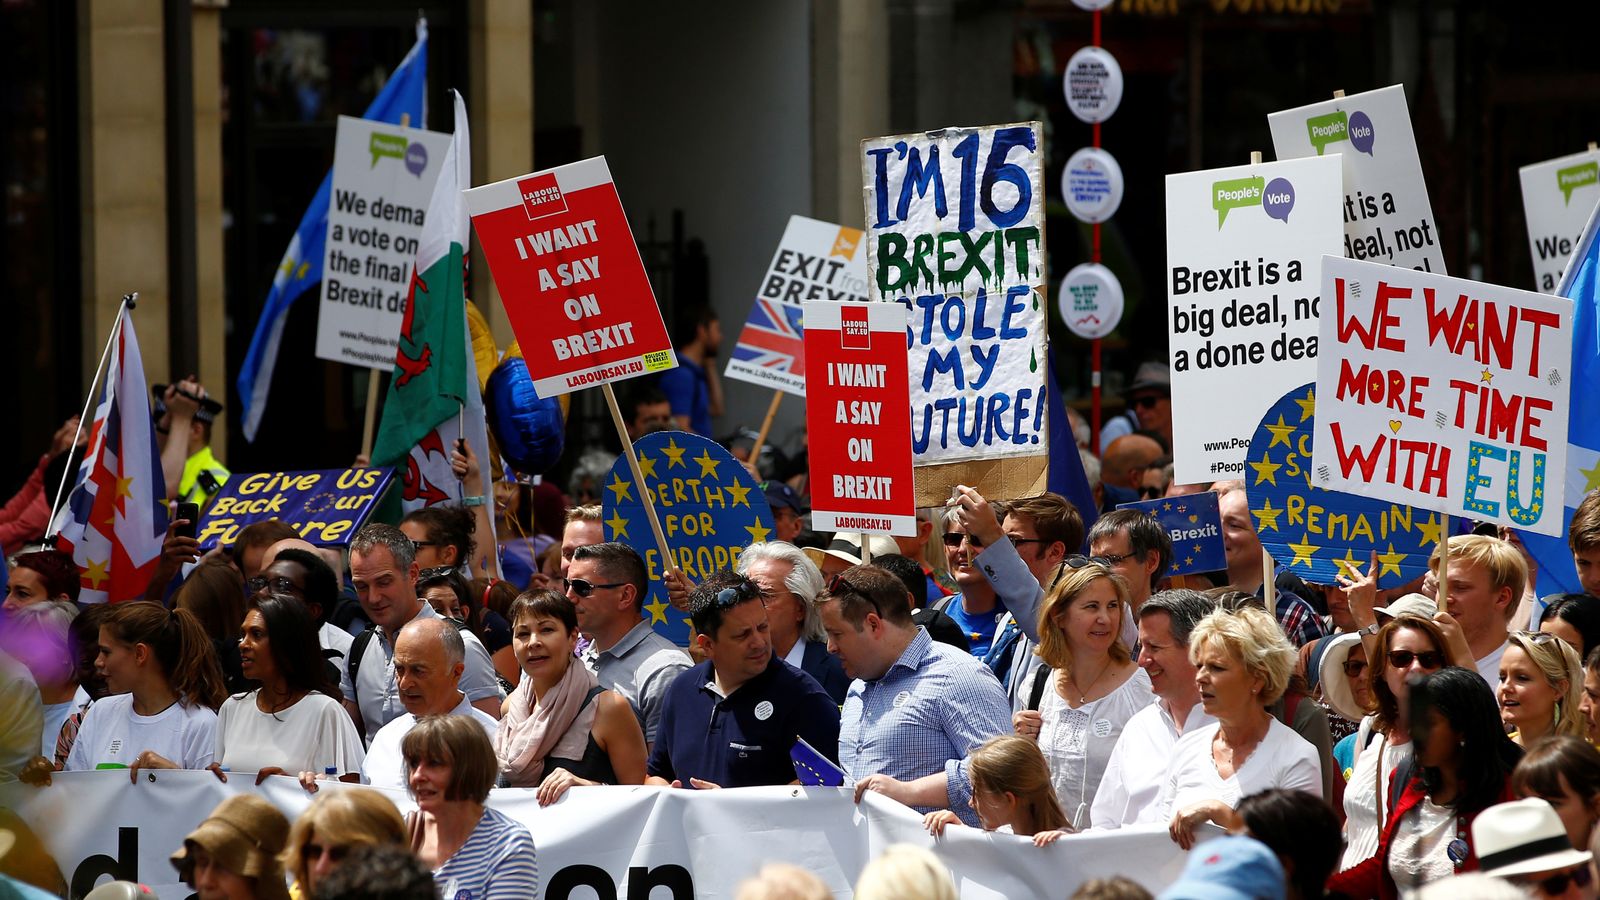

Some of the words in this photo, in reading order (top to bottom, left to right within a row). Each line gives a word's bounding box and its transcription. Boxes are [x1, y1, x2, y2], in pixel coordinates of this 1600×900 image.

[1312, 123, 1345, 137] People's
[1352, 126, 1370, 138] Vote
[523, 186, 559, 200] LABOUR
[866, 141, 948, 229] I'M
[952, 127, 1037, 232] 16
[336, 189, 366, 215] We
[531, 193, 561, 206] SAY.EU
[1218, 186, 1259, 201] People's
[1267, 193, 1290, 205] Vote
[1357, 191, 1378, 219] is
[1381, 192, 1396, 215] a
[333, 224, 343, 242] a
[349, 227, 390, 250] vote
[394, 236, 419, 255] on
[515, 238, 528, 260] I
[527, 219, 599, 256] WANT
[1395, 219, 1434, 252] not
[1536, 235, 1571, 261] We
[329, 250, 360, 275] the
[365, 255, 407, 283] final
[538, 268, 558, 292] A
[557, 256, 600, 286] SAY
[773, 249, 845, 285] EXIT
[840, 272, 868, 294] fro
[876, 226, 1040, 295] BREXIT
[1173, 259, 1251, 295] Brexit
[1258, 257, 1280, 285] is
[1287, 260, 1302, 282] a
[1542, 272, 1554, 291] a
[327, 279, 382, 310] Brexit
[563, 293, 601, 321] ON
[842, 320, 868, 328] LABOUR
[1174, 304, 1214, 337] big
[1222, 294, 1287, 328] deal,
[1335, 277, 1413, 353] WE
[1423, 287, 1560, 379] WANT
[552, 321, 635, 360] BREXIT
[922, 344, 1000, 393] MY
[1174, 350, 1189, 372] a
[1196, 340, 1265, 369] done
[566, 361, 643, 388] LABOURSAY.EU
[827, 362, 834, 386] I
[837, 363, 887, 388] WANT
[835, 400, 848, 424] A
[850, 400, 882, 425] SAY
[1336, 358, 1430, 419] MORE
[1450, 379, 1553, 452] TIME
[848, 437, 873, 462] ON
[1329, 422, 1451, 498] WITH
[238, 472, 321, 495] Give
[832, 474, 892, 500] BREXIT
[1463, 440, 1546, 526] EU
[208, 493, 288, 516] Back
[665, 512, 716, 538] FOR
[835, 516, 892, 531] LABOURSAY.EU
[1286, 495, 1412, 544] REMAIN
